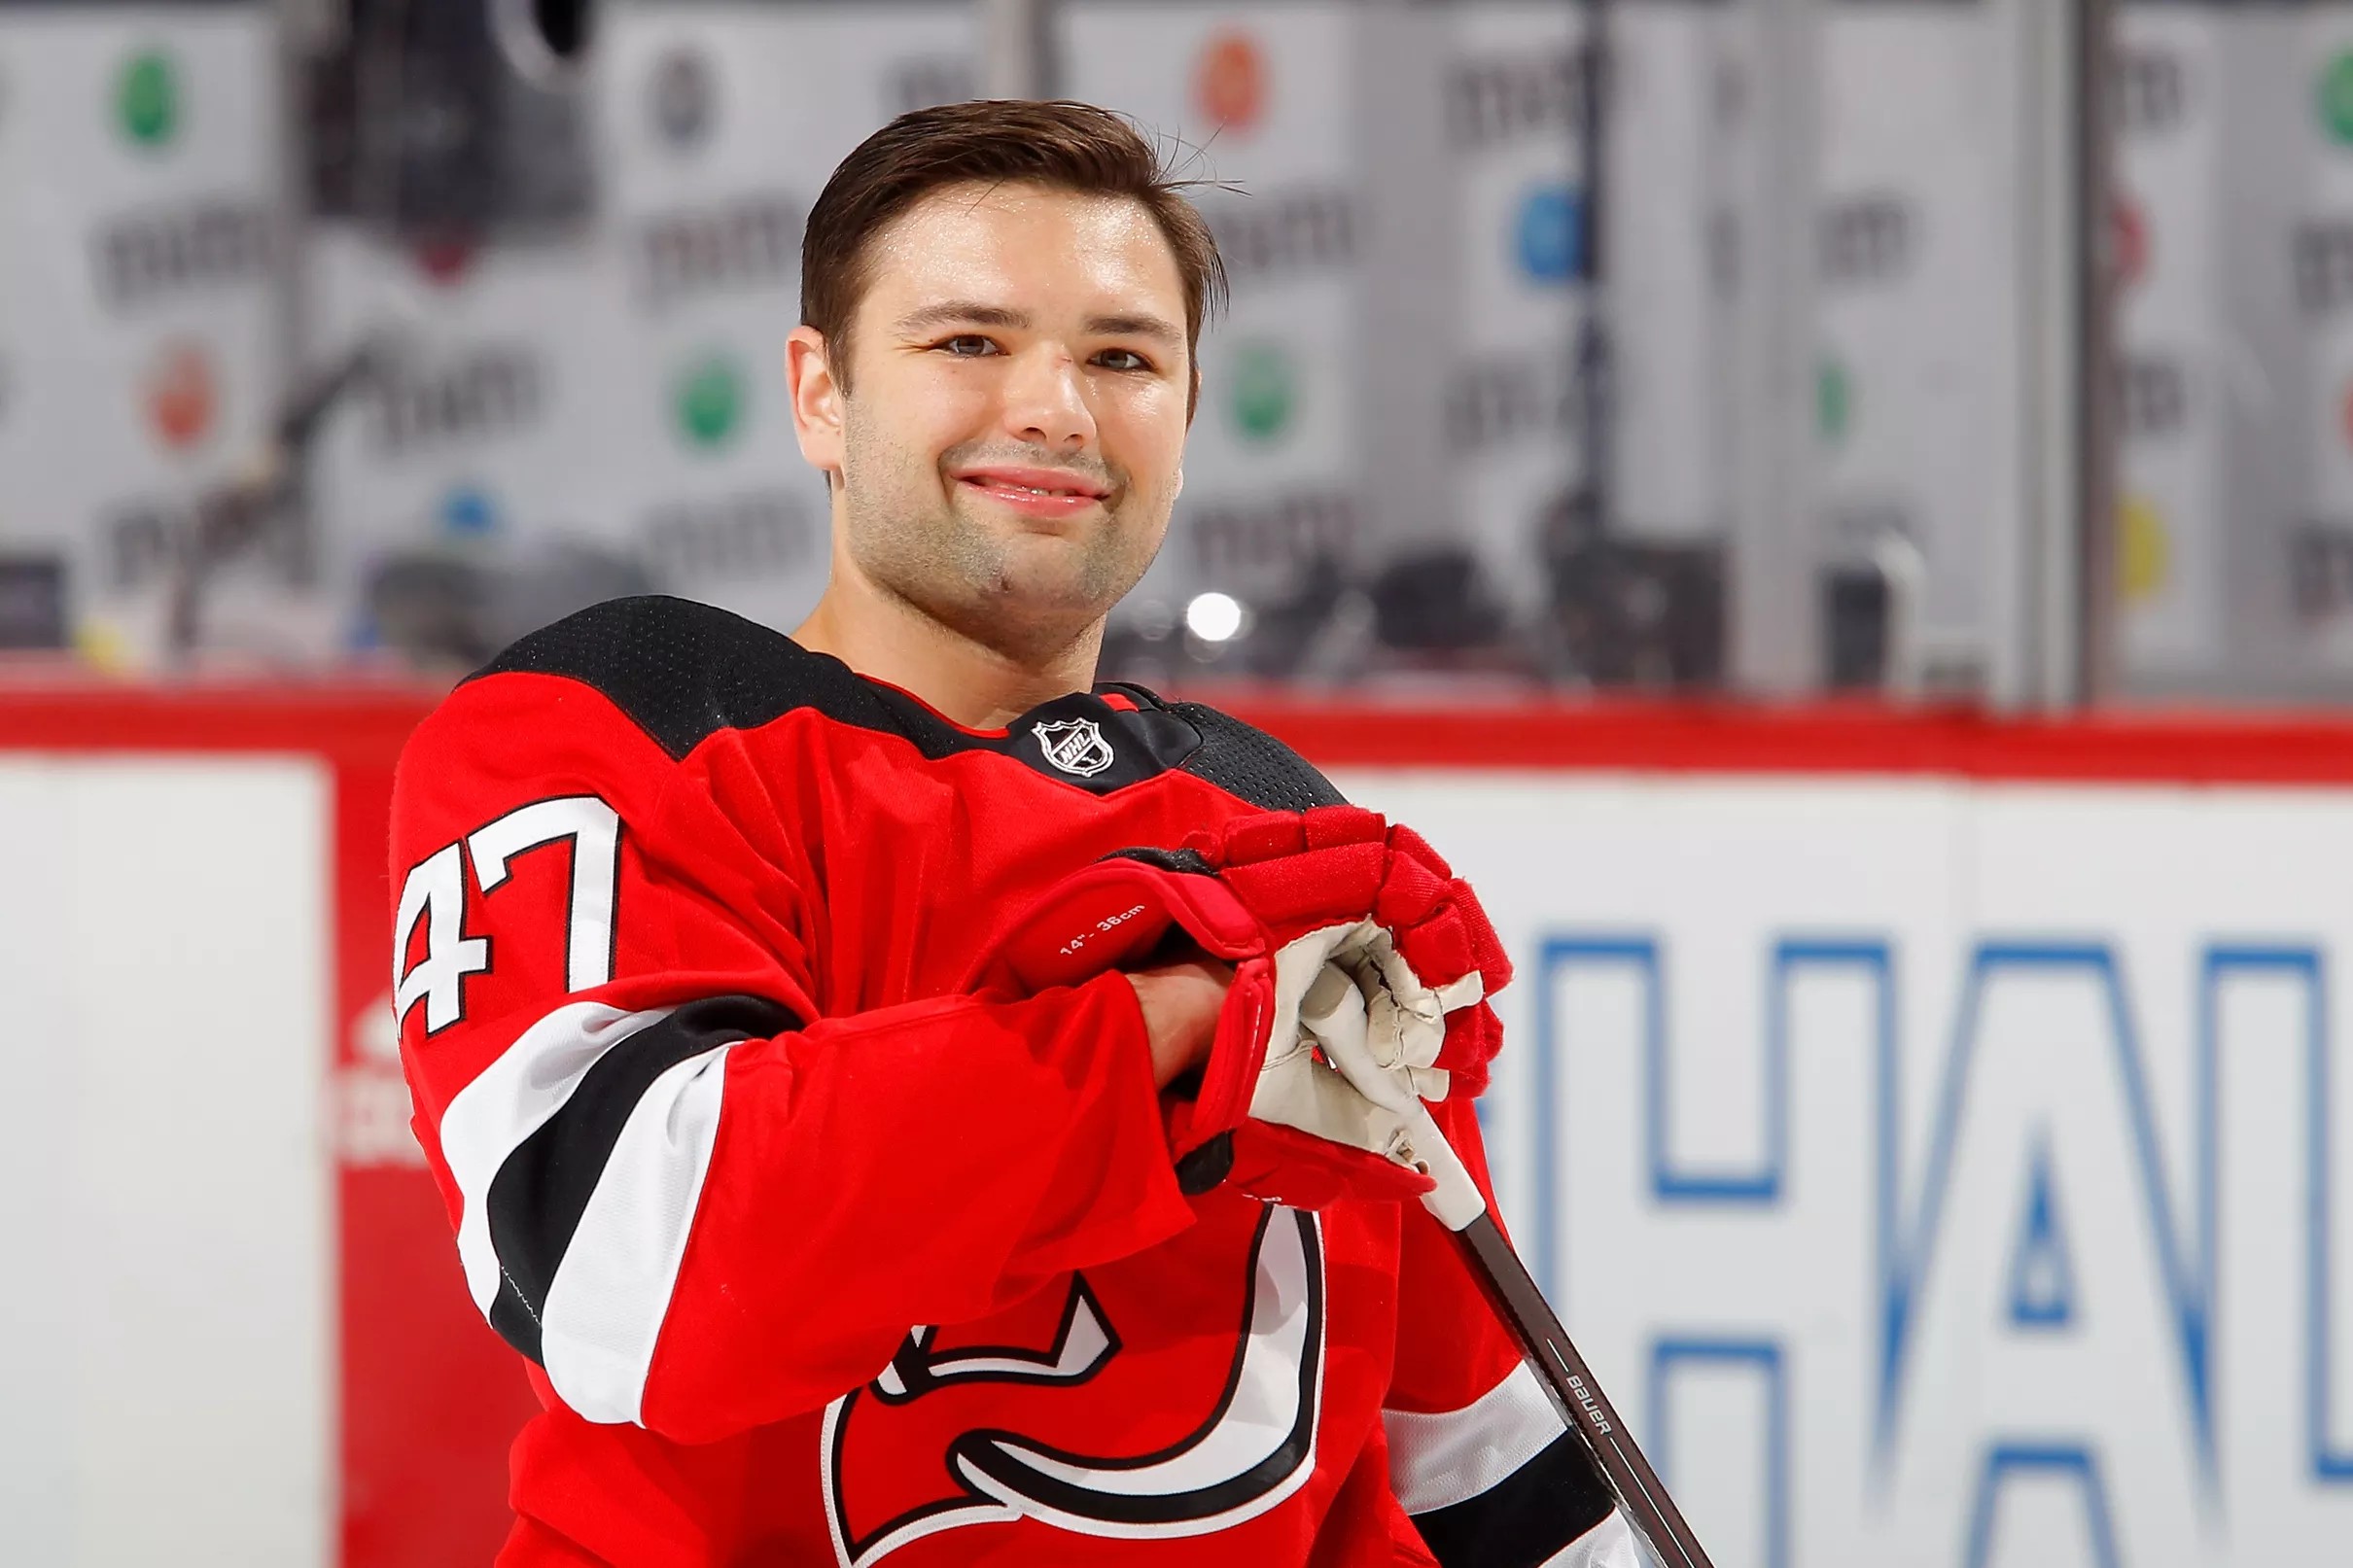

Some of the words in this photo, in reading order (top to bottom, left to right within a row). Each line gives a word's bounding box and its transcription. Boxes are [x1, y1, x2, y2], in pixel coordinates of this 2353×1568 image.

[1059, 732, 1091, 764] NHL
[393, 793, 621, 1039] 47
[1096, 904, 1145, 931] 36cm
